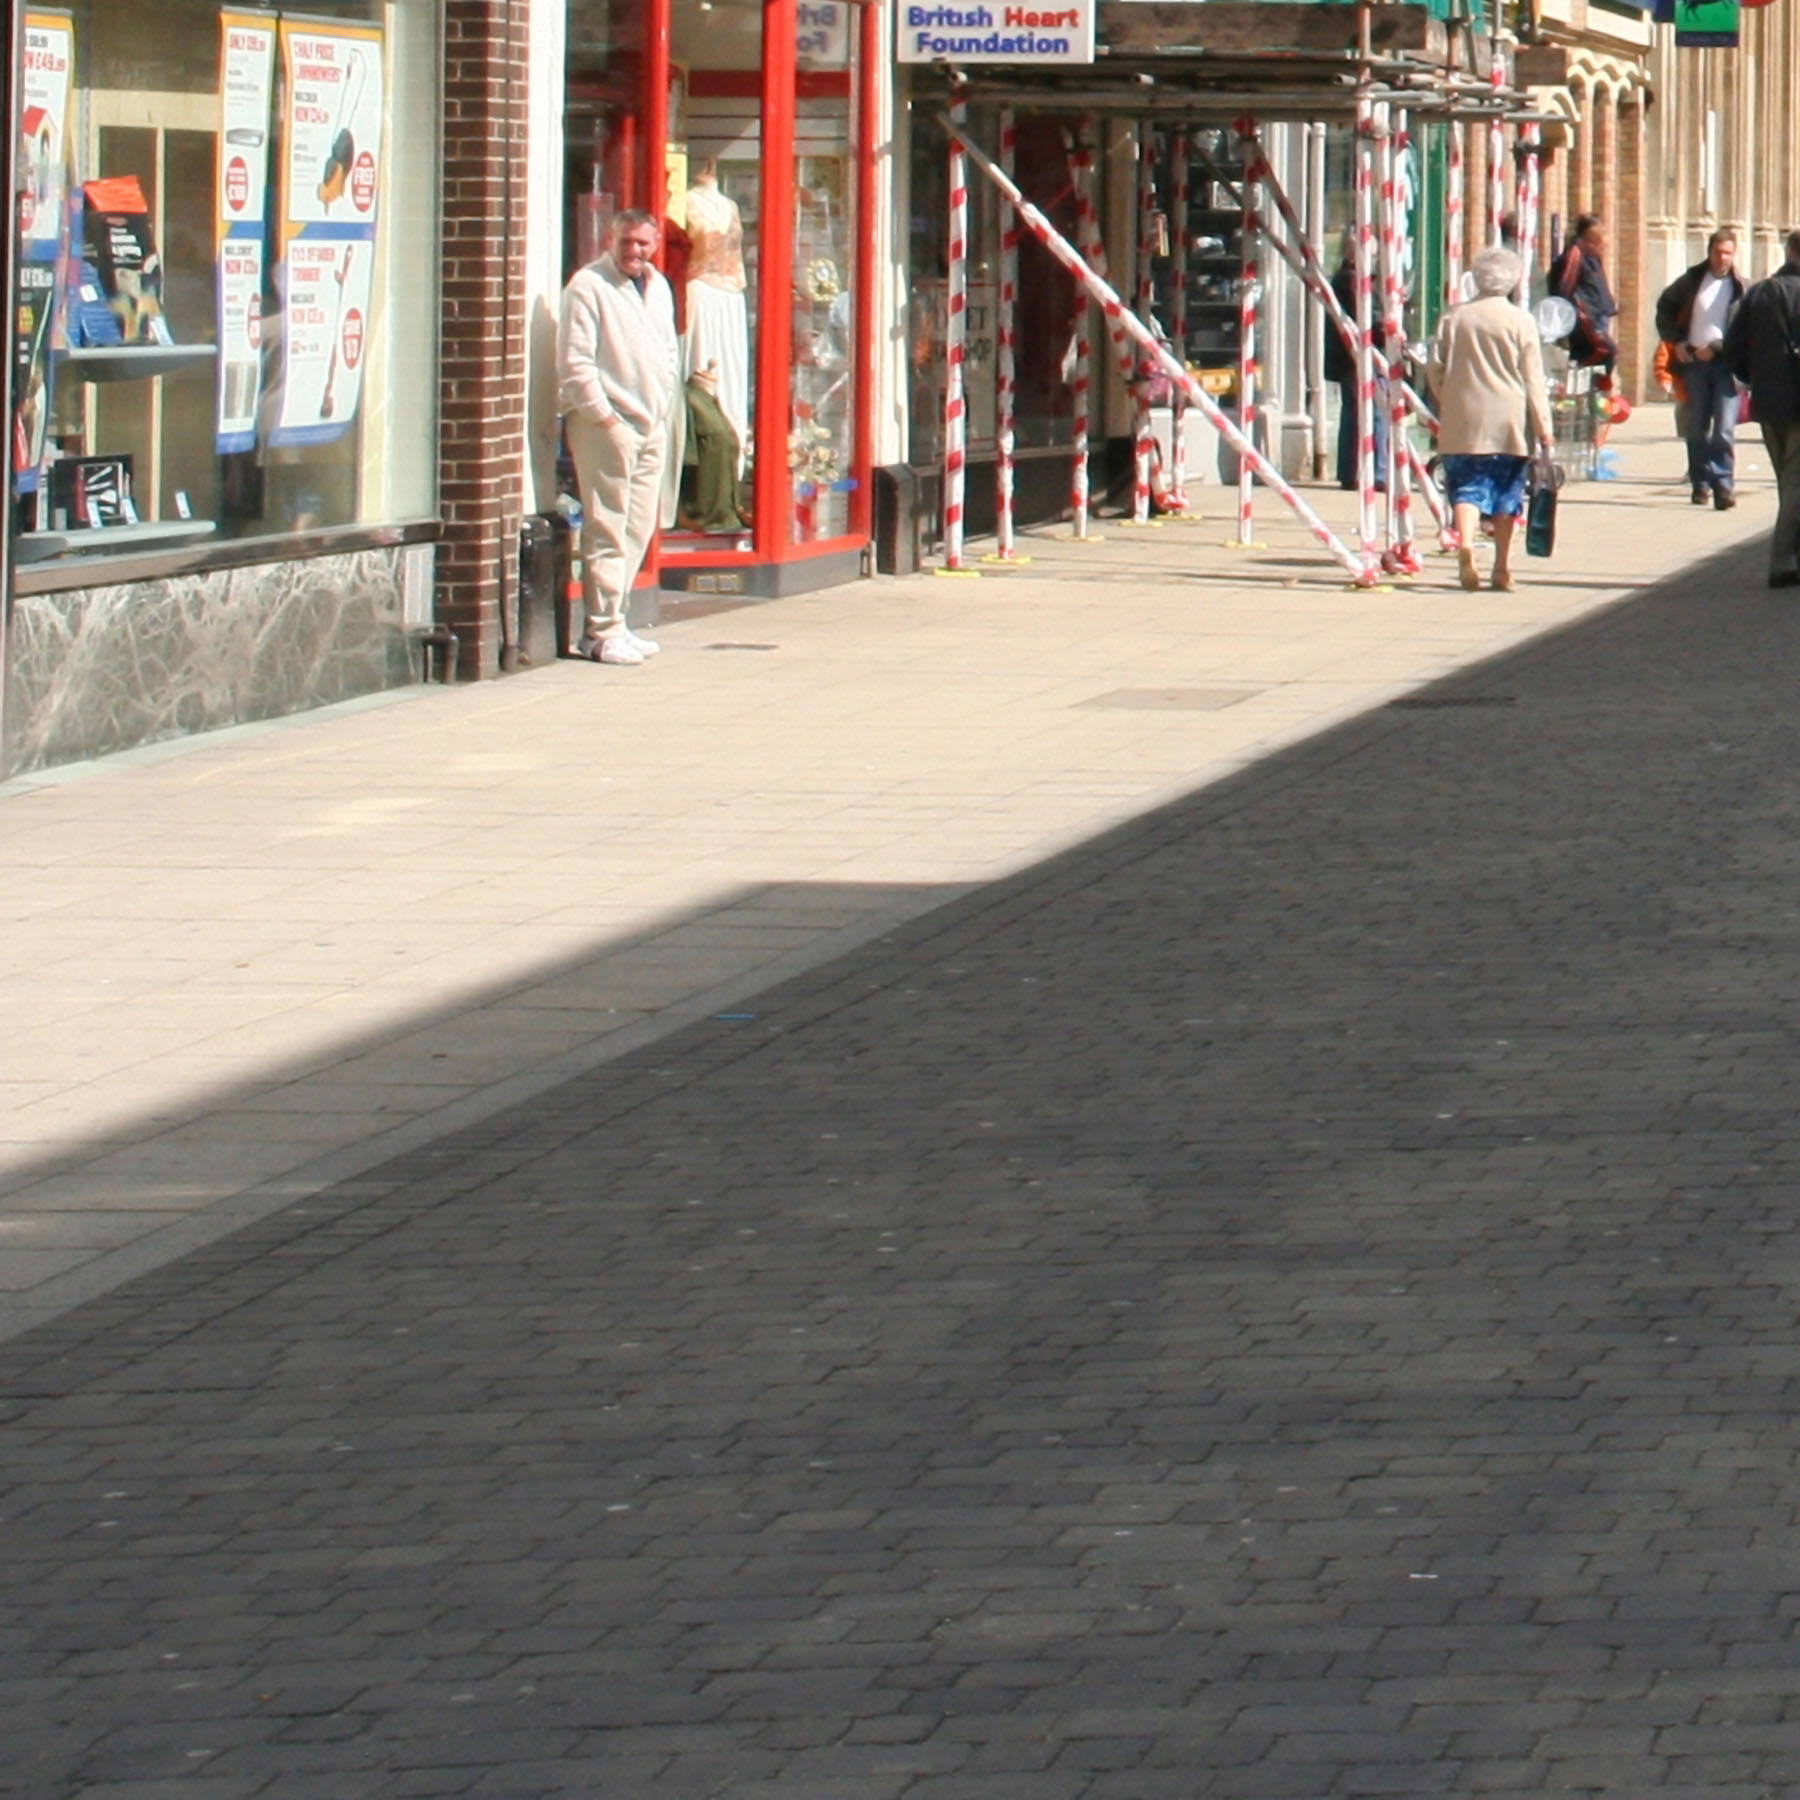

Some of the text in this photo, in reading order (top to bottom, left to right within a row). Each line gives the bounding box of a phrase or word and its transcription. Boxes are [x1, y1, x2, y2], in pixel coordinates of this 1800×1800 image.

[908, 5, 1079, 28] British Heart
[916, 31, 1069, 53] Foundation
